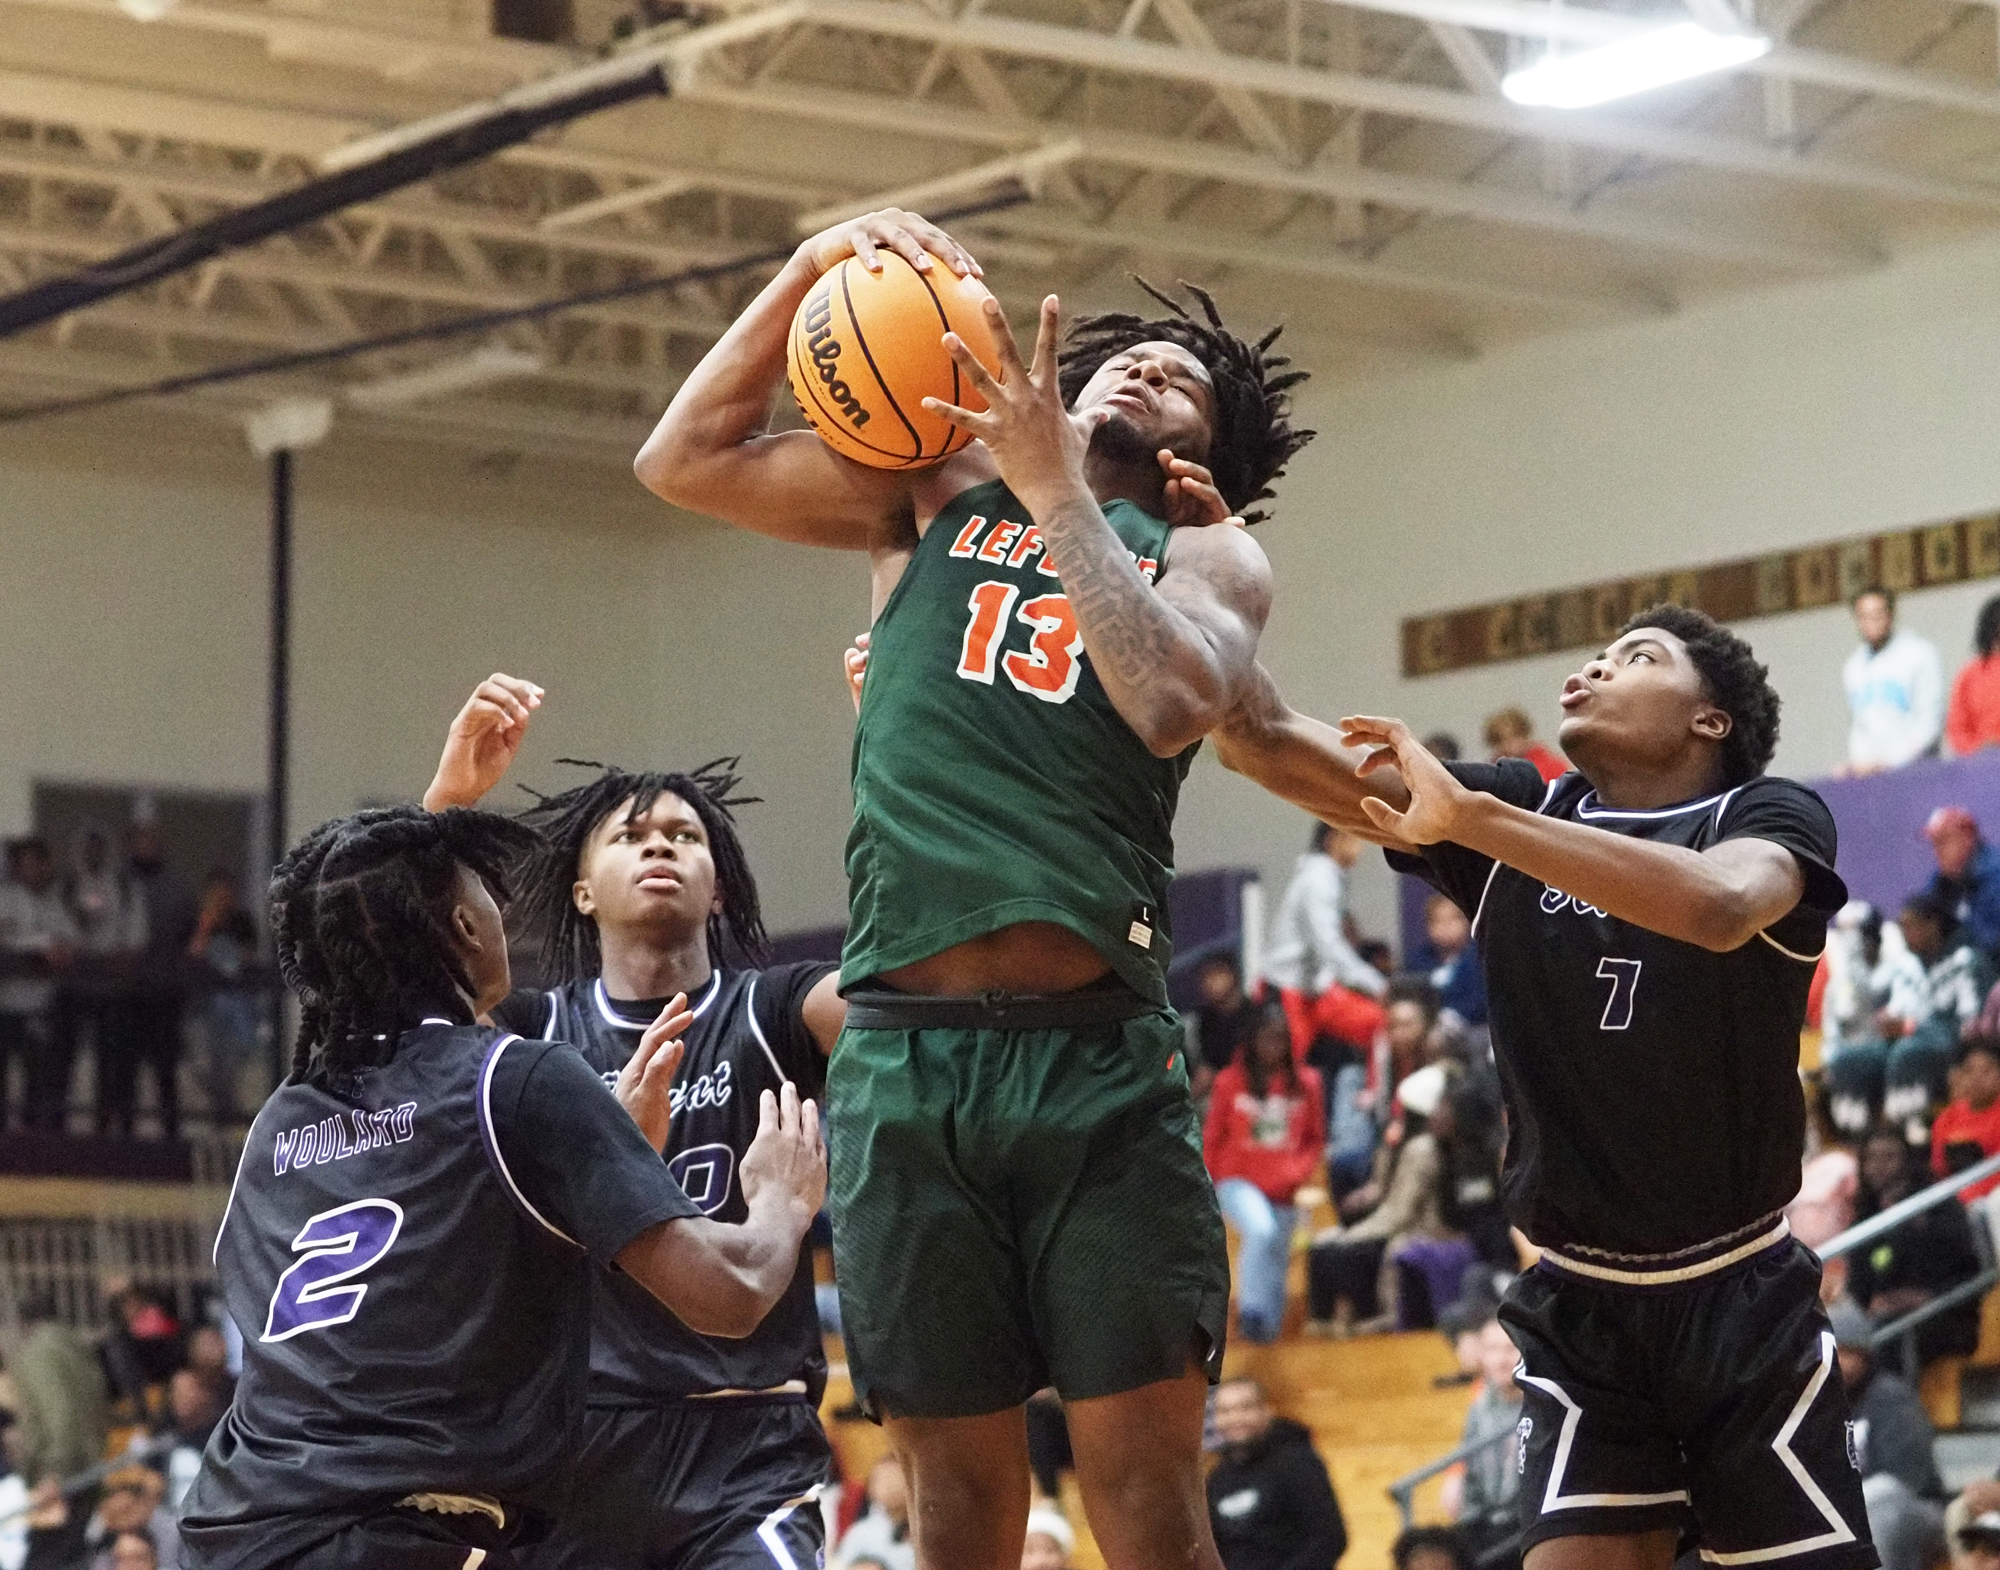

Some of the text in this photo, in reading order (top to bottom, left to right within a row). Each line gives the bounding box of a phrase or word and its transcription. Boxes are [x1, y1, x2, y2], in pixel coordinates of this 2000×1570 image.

[804, 283, 870, 430] Wilson
[956, 580, 1085, 704] 13
[1143, 906, 1150, 922] L
[1596, 957, 1642, 1031] 7
[259, 1198, 404, 1343] 2
